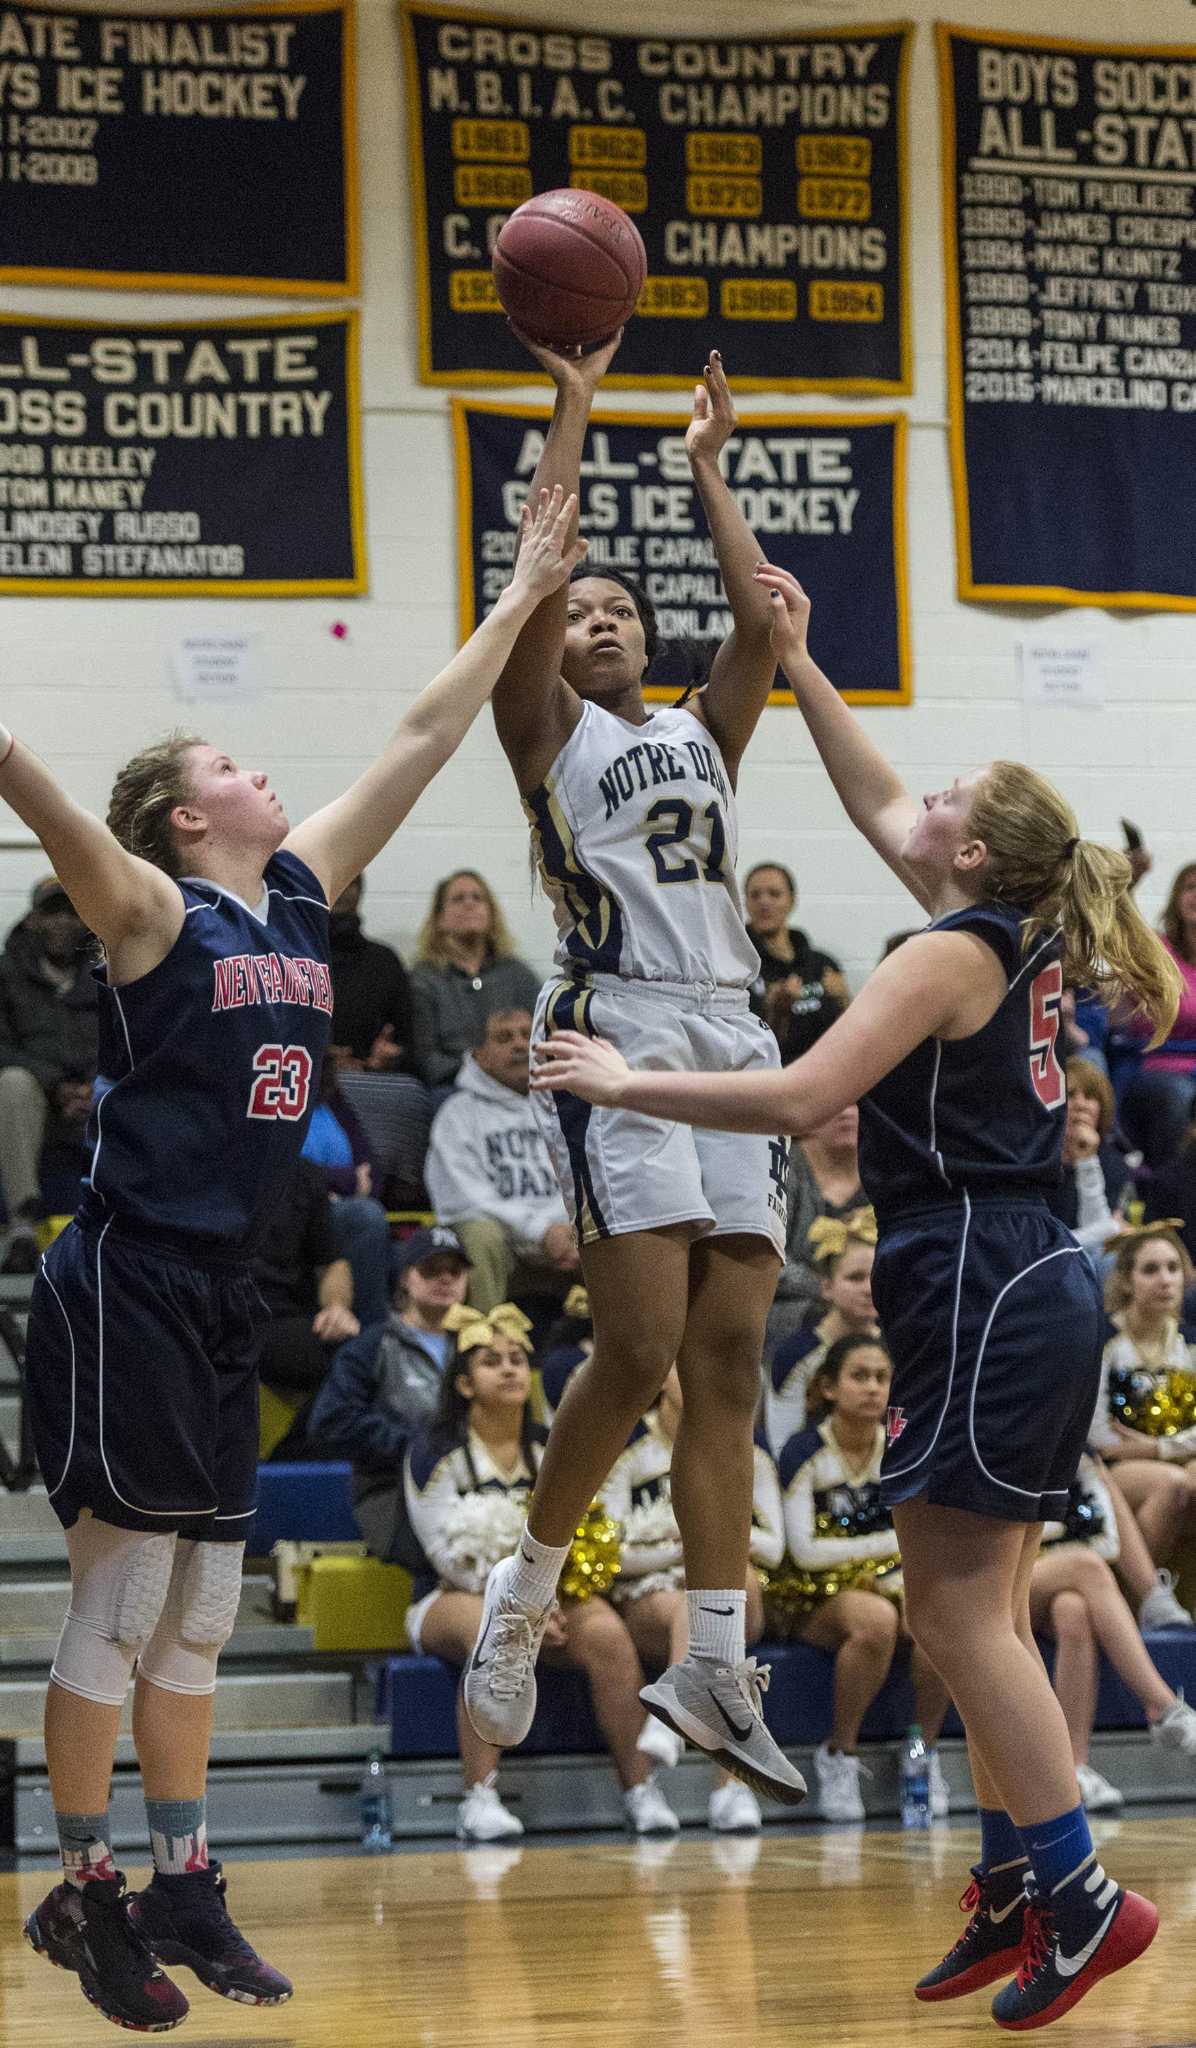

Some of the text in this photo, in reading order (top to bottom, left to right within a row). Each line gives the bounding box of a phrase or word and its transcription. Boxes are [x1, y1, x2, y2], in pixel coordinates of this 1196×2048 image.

[102, 22, 297, 67] FINALIST
[438, 24, 880, 79] CROSS COUNTRY
[57, 66, 124, 113] ICE
[143, 71, 306, 120] HOCKEY
[659, 83, 891, 128] CHAMPIONS
[979, 50, 1078, 108] BOYS
[664, 220, 887, 271] CHAMPIONS
[104, 389, 332, 438] COUNTRY
[52, 446, 157, 478] KEELEY
[54, 479, 146, 510] MANEY
[630, 484, 695, 531] ICE
[728, 487, 862, 536] OCKEY
[598, 742, 687, 821] NOTRE
[644, 797, 726, 884] 21
[212, 955, 265, 1013] NEW
[1029, 959, 1066, 1112] 5
[247, 1044, 312, 1121] 23
